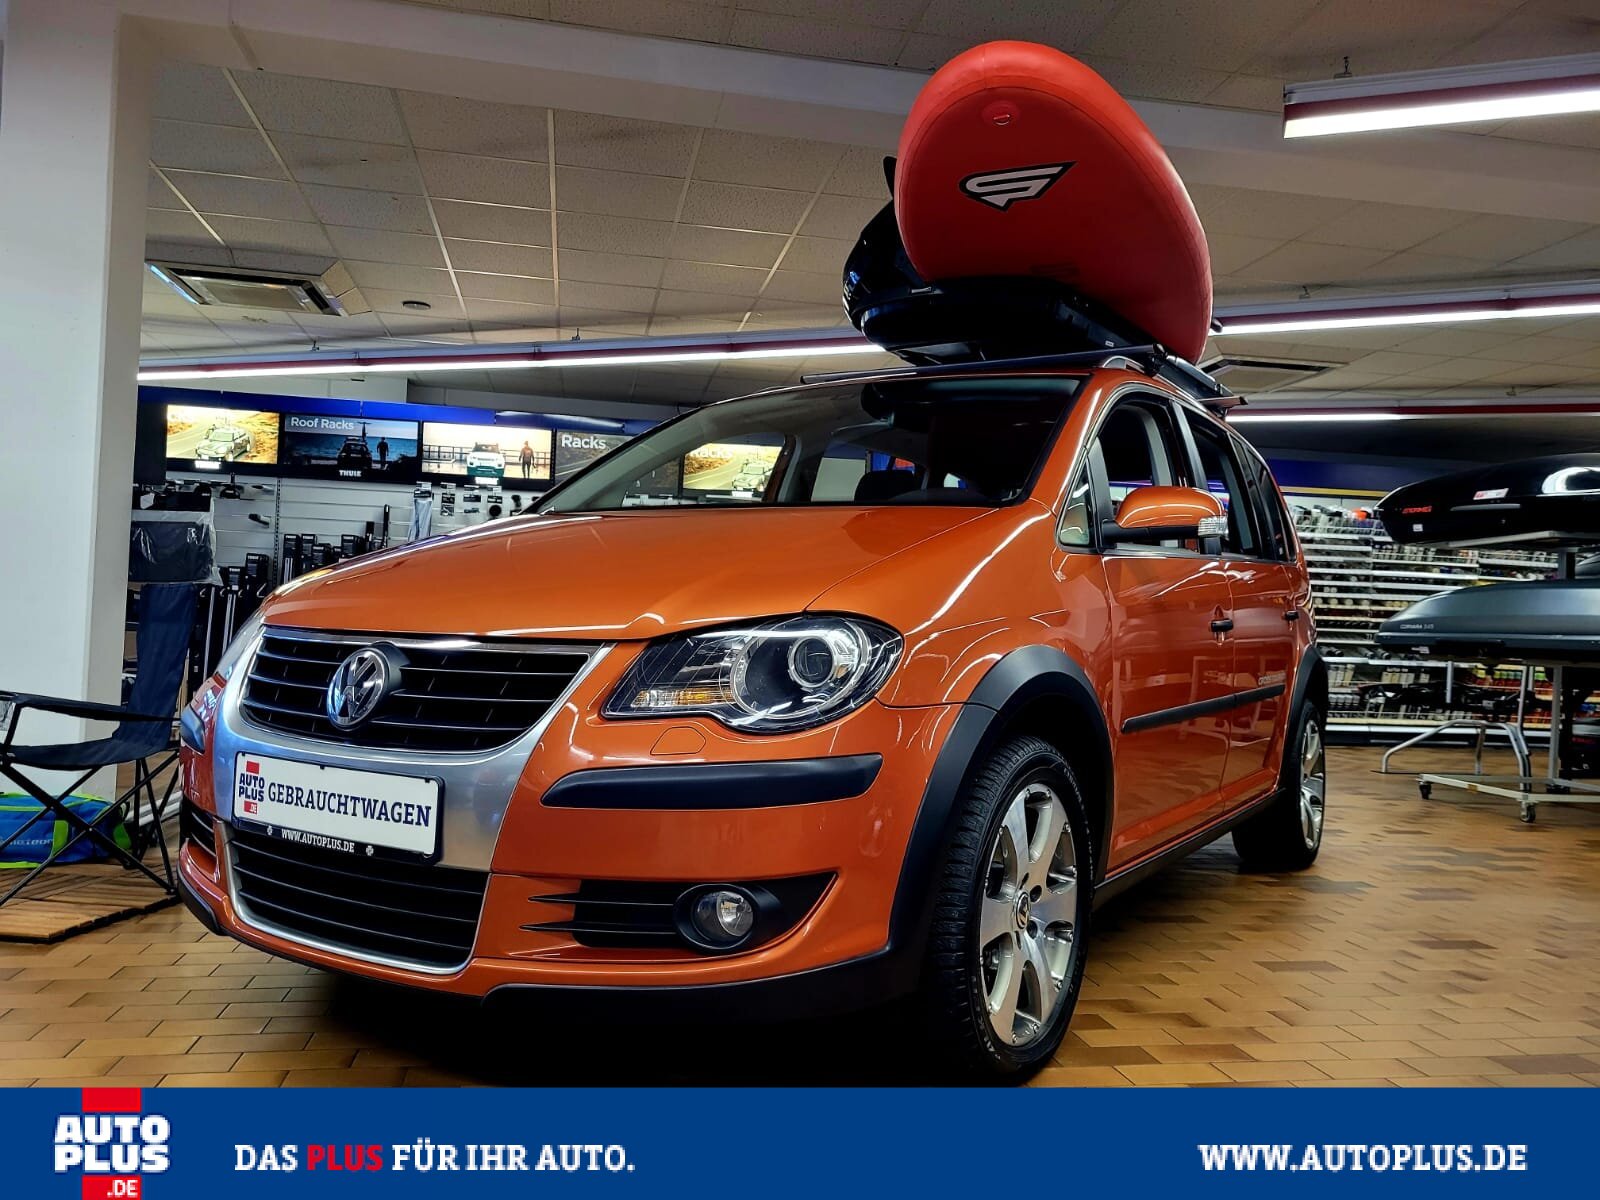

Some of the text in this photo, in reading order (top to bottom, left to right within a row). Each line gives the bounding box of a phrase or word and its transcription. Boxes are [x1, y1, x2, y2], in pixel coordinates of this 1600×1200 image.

[290, 416, 354, 430] Roof Racks
[561, 434, 607, 450] Racks
[338, 469, 362, 478] THULE
[239, 773, 265, 789] AUTO
[238, 786, 264, 802] PLUS
[268, 782, 432, 827] GEBRAUCHTWAGEN
[281, 829, 355, 853] WWW.AUTOPLUS.DE
